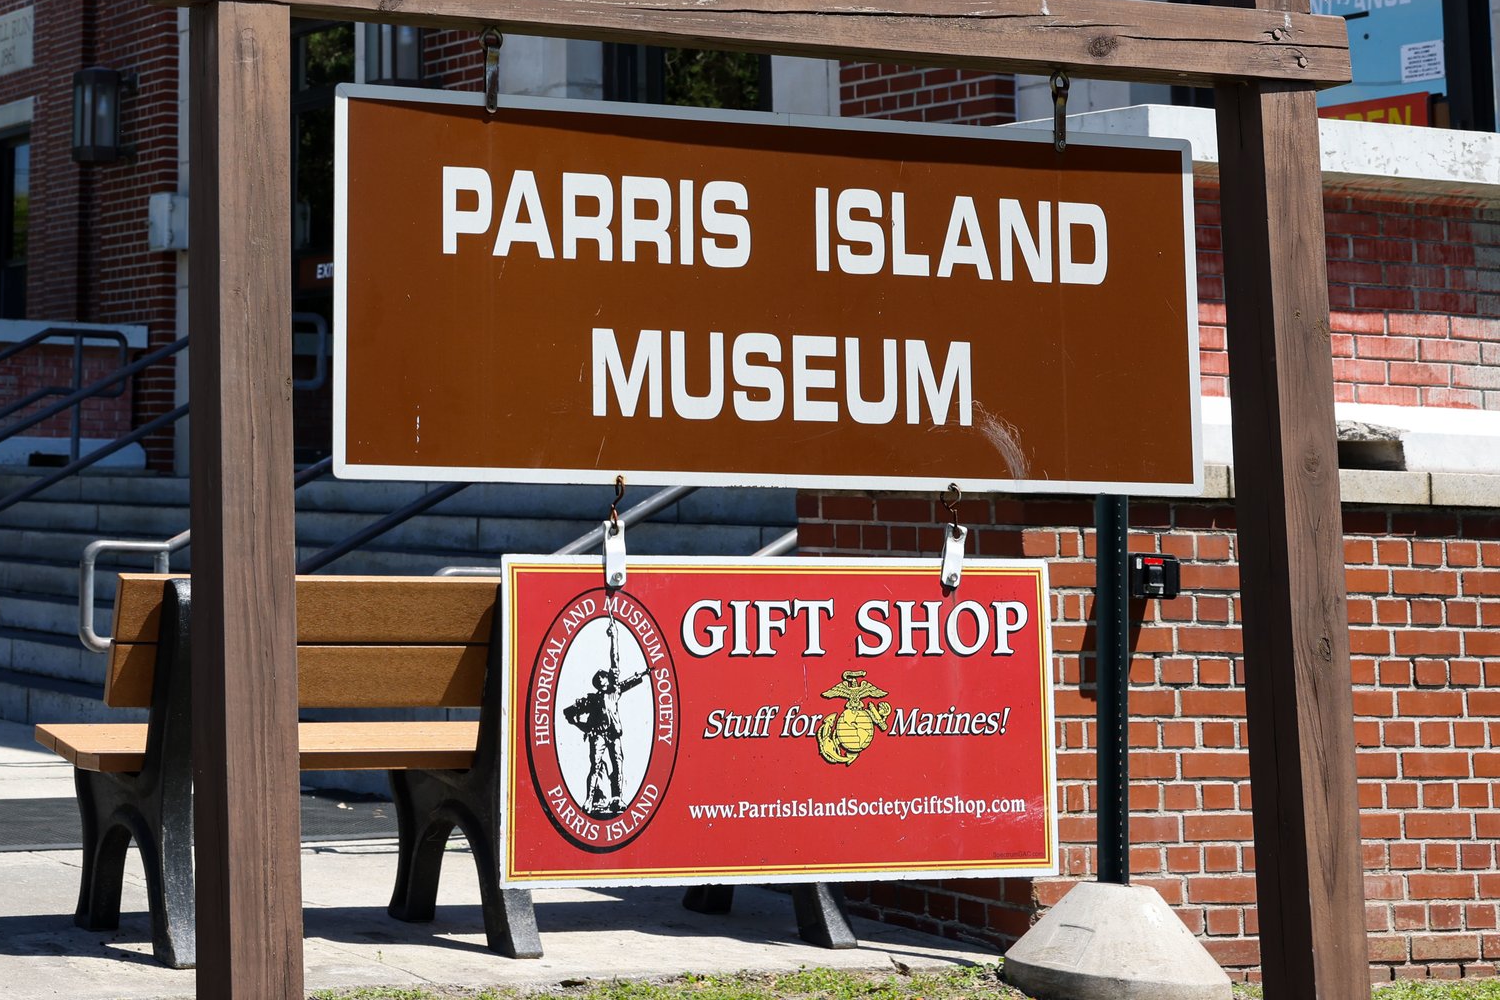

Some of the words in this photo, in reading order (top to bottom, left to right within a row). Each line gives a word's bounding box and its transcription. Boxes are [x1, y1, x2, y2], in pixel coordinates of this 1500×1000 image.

[442, 165, 751, 268] PARRIS
[815, 187, 1108, 285] ISLAND
[592, 328, 972, 426] MUSEUM
[681, 598, 834, 658] GIFT
[855, 600, 1028, 658] SHOP
[535, 637, 566, 746] HISTORICAL
[562, 598, 596, 635] AND
[603, 596, 664, 663] MUSEUM
[655, 667, 674, 745] SOCIETY
[703, 705, 779, 739] Stuff
[780, 705, 822, 738] for
[887, 705, 1011, 737] Marines!
[548, 784, 599, 841] PARRIS
[605, 784, 659, 842] ISLAND
[689, 796, 1026, 820] www.ParrisIslandSocietyGiftShop.com
